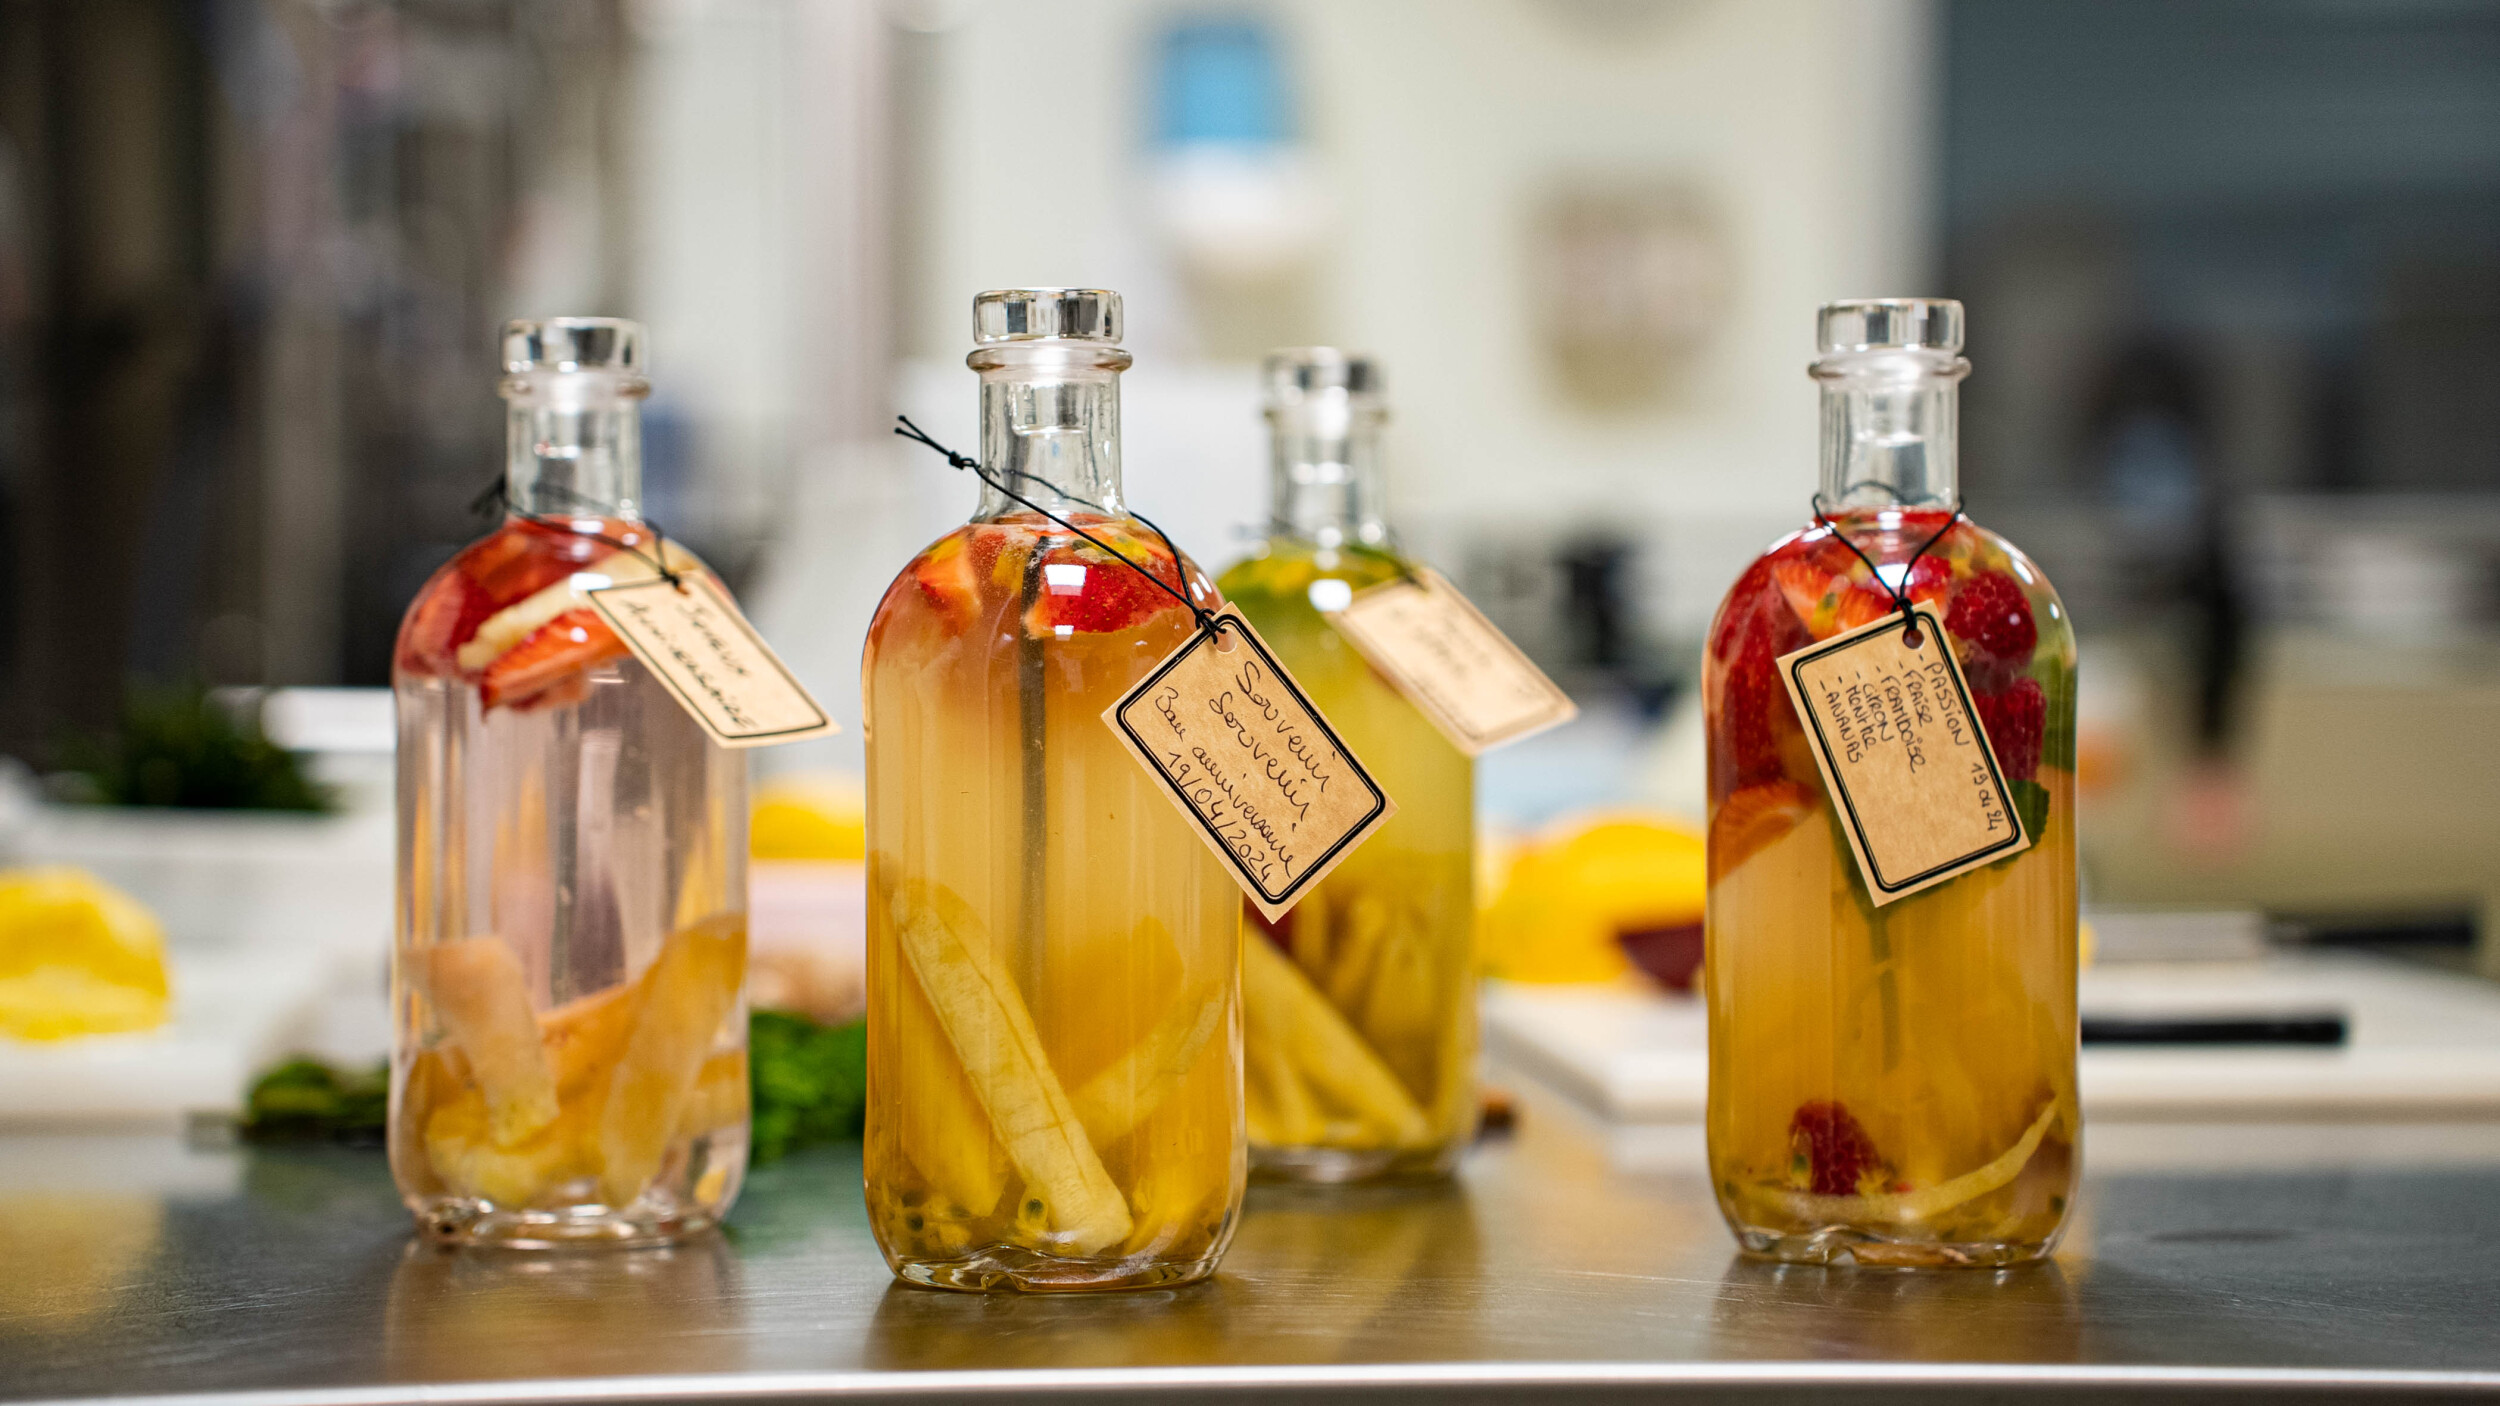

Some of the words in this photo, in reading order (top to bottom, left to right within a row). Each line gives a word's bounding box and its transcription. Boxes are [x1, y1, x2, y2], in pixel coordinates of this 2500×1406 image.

[1154, 686, 1186, 743] Bon
[1191, 745, 1297, 879] anniversaire
[1209, 691, 1310, 822] Souvenir
[1236, 661, 1336, 793] Souvenir
[1825, 691, 1863, 765] ANANAS
[1168, 751, 1274, 883] 19/04/2024
